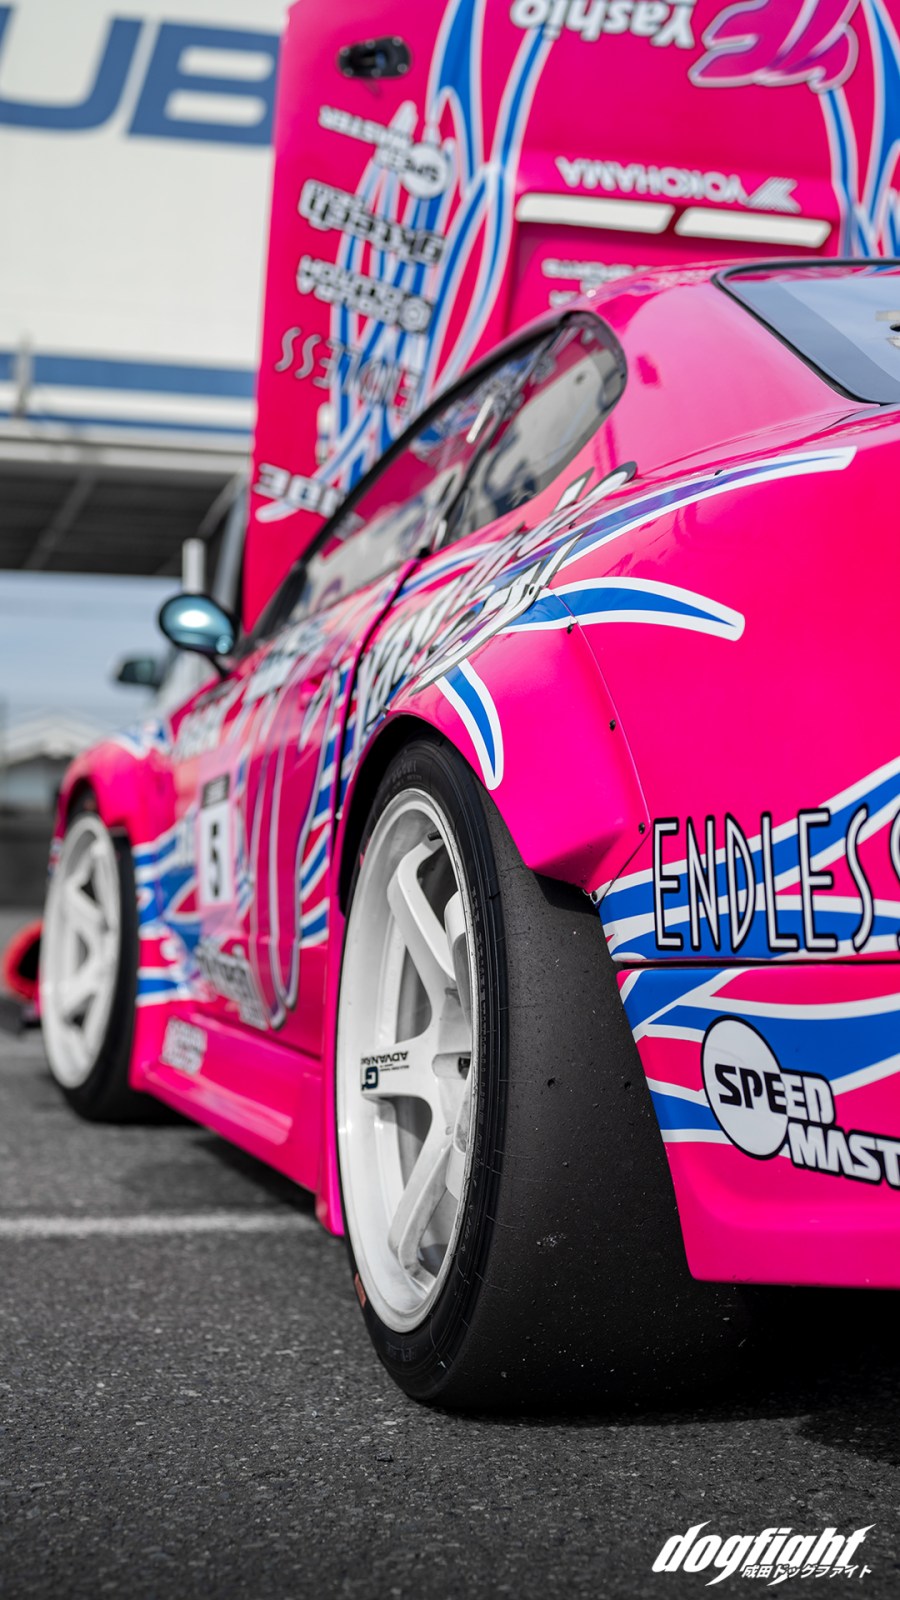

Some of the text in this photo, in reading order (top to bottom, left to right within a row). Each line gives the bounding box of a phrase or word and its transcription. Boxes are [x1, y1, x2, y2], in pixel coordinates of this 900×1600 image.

[511, 0, 695, 48] Yashio
[555, 156, 747, 205] YOKOHAMA
[714, 1063, 836, 1126] SPEED
[787, 1121, 900, 1189] MAST
